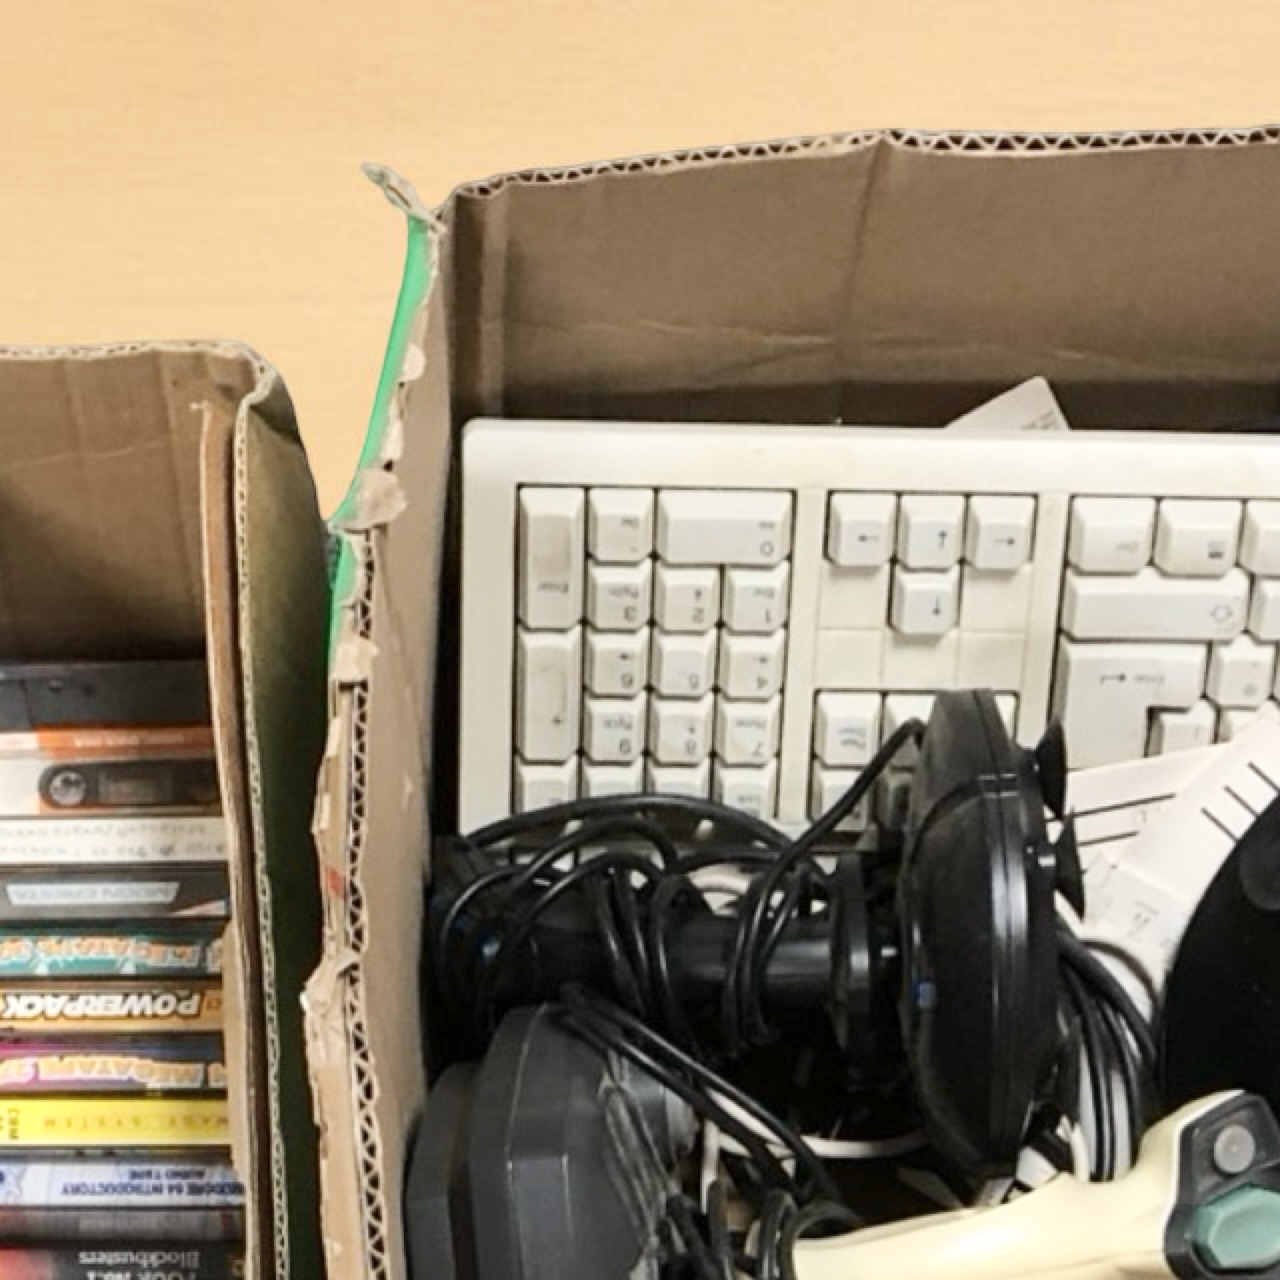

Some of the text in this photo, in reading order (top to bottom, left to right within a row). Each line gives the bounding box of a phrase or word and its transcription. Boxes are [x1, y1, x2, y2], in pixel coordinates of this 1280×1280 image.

[624, 606, 636, 622] 3
[620, 673, 633, 688] 6
[619, 740, 631, 756] 9
[0, 993, 200, 1019] POWERPACK
[60, 1182, 164, 1196] INTRODUCTORY
[79, 1250, 200, 1269] Blockbusters
